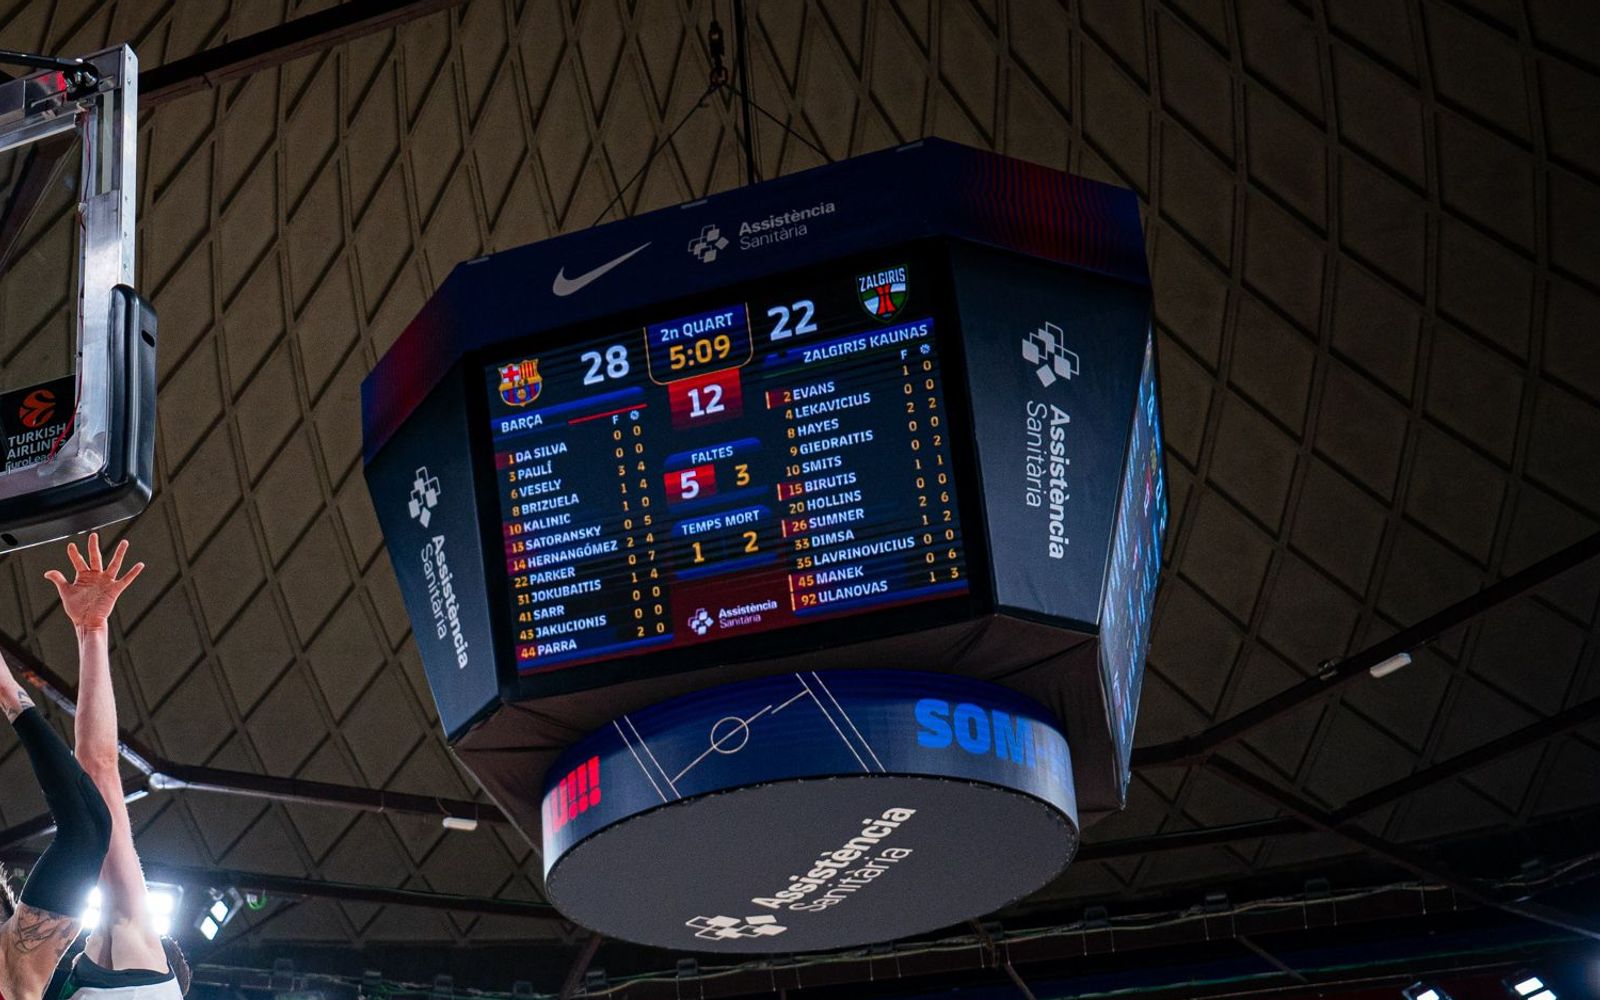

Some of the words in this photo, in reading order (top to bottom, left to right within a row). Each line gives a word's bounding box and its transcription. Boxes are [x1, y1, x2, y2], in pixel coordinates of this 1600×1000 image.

[739, 203, 835, 236] Assistència
[740, 224, 807, 250] Sanitària
[859, 268, 906, 292] ZALGIRIS
[660, 327, 680, 342] 2n
[683, 312, 734, 338] QUART
[767, 300, 817, 341] 22
[669, 334, 731, 370] 5:09
[804, 339, 867, 363] ZALGIRIS
[870, 324, 928, 348] KAUNAS
[901, 350, 907, 360] F
[581, 345, 629, 386] 28
[784, 392, 791, 402] 2
[793, 381, 835, 400] EVANS
[903, 365, 909, 376] 1
[923, 360, 931, 371] 0
[688, 384, 725, 417] 12
[785, 410, 793, 420] 4
[795, 392, 870, 418] LEKAVICIUS
[502, 414, 543, 433] BARÇA
[613, 415, 619, 424] F
[787, 428, 795, 438] 8
[797, 419, 839, 437] HAYES
[907, 403, 914, 413] 2
[928, 398, 936, 408] 2
[8, 423, 67, 447] TURKISH
[508, 455, 514, 464] 1
[516, 450, 532, 463] DA
[534, 442, 567, 459] SILVA
[613, 430, 621, 440] 0
[633, 426, 641, 436] 0
[790, 447, 797, 456] 9
[800, 430, 873, 455] GIEDRAITIS
[691, 446, 733, 464] FALTES
[786, 465, 800, 477] 10
[802, 456, 842, 473] SMITS
[1027, 401, 1047, 507] Sanitària
[510, 472, 516, 482] 3
[511, 490, 518, 499] 6
[519, 479, 562, 497] VESELY
[619, 466, 625, 475] 3
[637, 461, 645, 471] 4
[680, 471, 699, 499] 5
[735, 464, 750, 486] 3
[790, 483, 802, 495] 15
[805, 473, 856, 492] BIRUTIS
[915, 459, 921, 469] 1
[937, 455, 943, 465] 1
[1049, 404, 1070, 559] Assistència
[512, 507, 519, 516] 8
[522, 494, 579, 515] BRIZUELA
[621, 484, 627, 494] 1
[640, 479, 647, 489] 4
[790, 502, 804, 514] 20
[807, 490, 862, 511] HOLLINS
[792, 520, 807, 532] 26
[809, 508, 864, 529] SUMNER
[919, 496, 927, 507] 2
[941, 492, 949, 502] 6
[509, 524, 522, 535] 10
[524, 513, 571, 532] KALINIC
[682, 520, 721, 535] TEMPS
[725, 510, 760, 527] MORT
[512, 542, 524, 553] 13
[526, 526, 601, 550] SATORANSKY
[514, 559, 526, 570] 14
[528, 540, 618, 568] HERNANGÓMEZ
[627, 537, 634, 547] 2
[646, 533, 654, 543] 4
[692, 542, 704, 563] 1
[743, 531, 759, 553] 2
[795, 538, 809, 551] 33
[812, 529, 855, 547] DIMSA
[797, 557, 812, 569] 35
[814, 537, 915, 566] LAVRINOVICIUS
[421, 543, 447, 640] Sanitària
[515, 577, 528, 588] 22
[530, 567, 576, 585] PARKER
[518, 594, 530, 605] 31
[532, 580, 601, 603] JOKUBAITIS
[632, 573, 638, 583] 1
[651, 568, 658, 578] 4
[798, 575, 814, 587] 45
[816, 566, 864, 584] MANEK
[802, 593, 817, 606] 92
[819, 580, 888, 603] ULANOVAS
[929, 572, 936, 582] 1
[951, 568, 958, 578] 3
[432, 535, 469, 669] Assistència
[519, 611, 532, 622] 41
[534, 605, 565, 620] SARR
[719, 600, 777, 618] Assistència
[521, 647, 536, 658] 44
[538, 639, 577, 656] PARRA
[751, 807, 917, 909] Assistència
[788, 847, 913, 912] Sanitària
